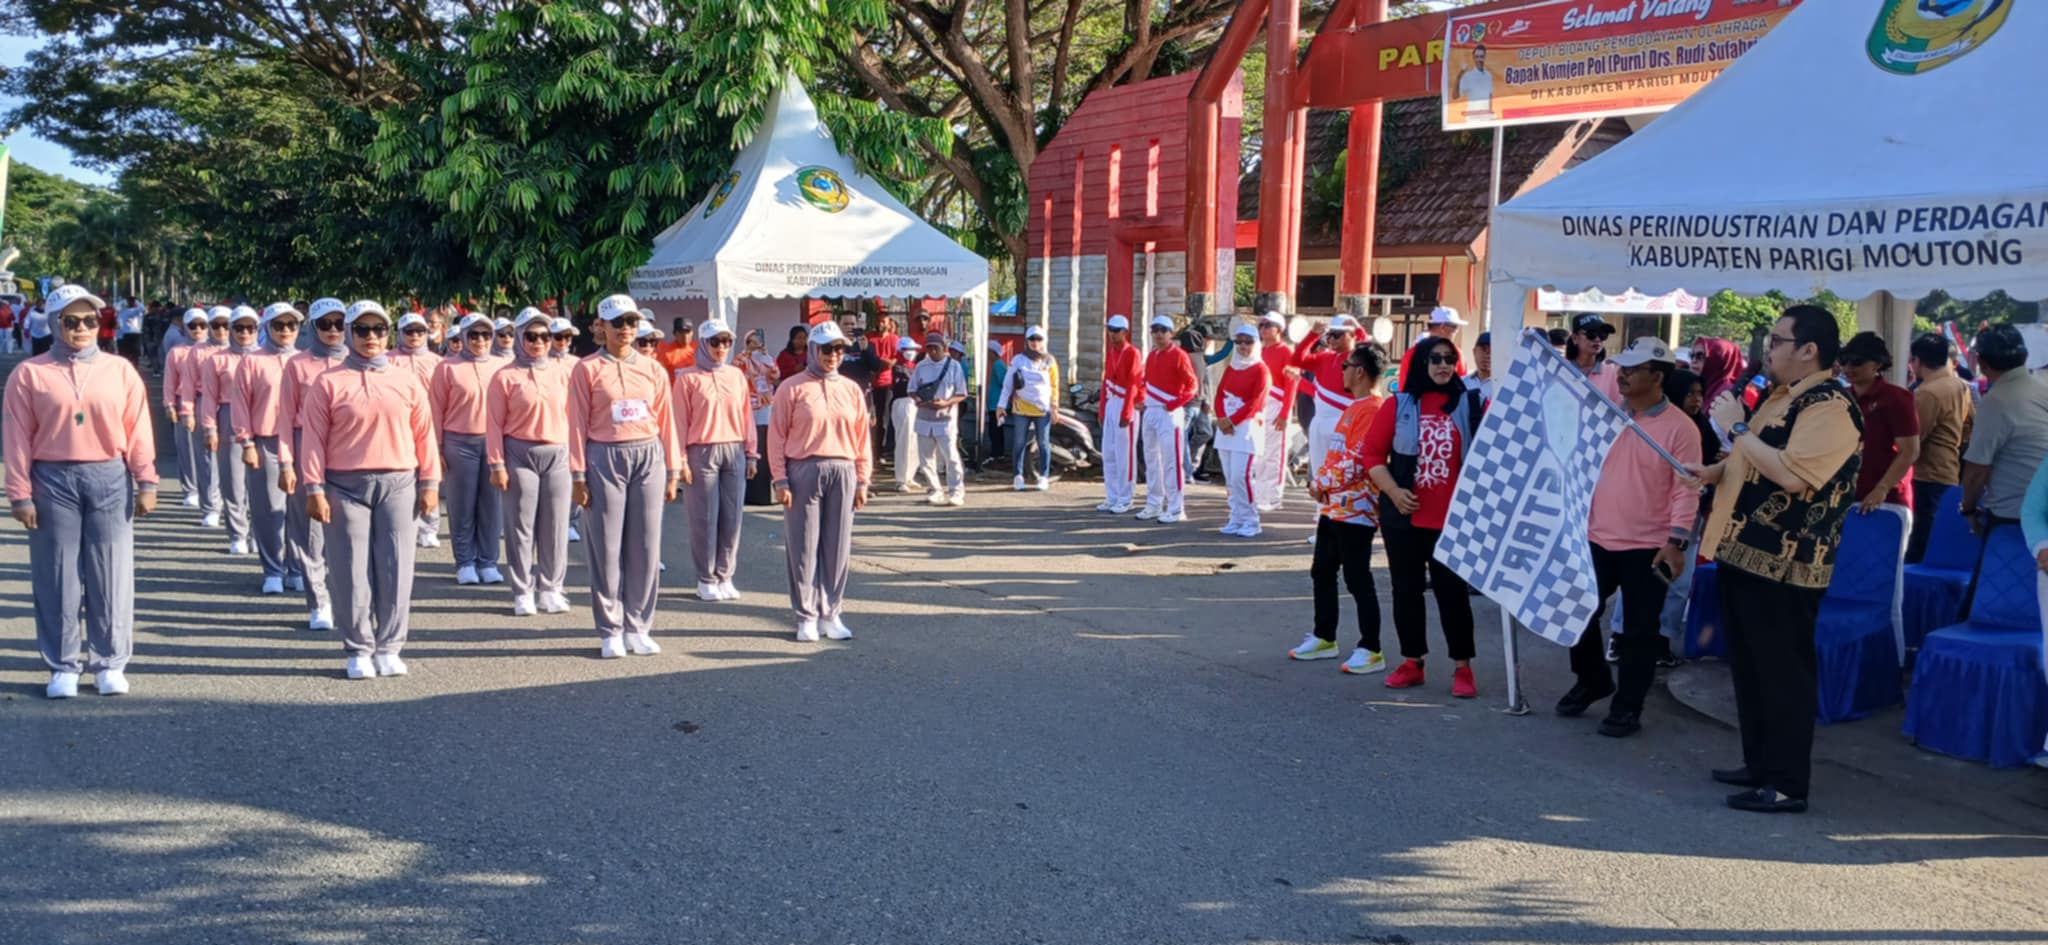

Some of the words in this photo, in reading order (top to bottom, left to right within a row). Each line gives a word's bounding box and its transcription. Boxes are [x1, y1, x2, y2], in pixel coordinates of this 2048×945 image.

[1562, 1, 1637, 31] Selamat
[1519, 46, 1556, 60] DEPUTI
[1559, 39, 1600, 56] BIDANG
[1698, 17, 1768, 38] OLAHRAGA
[1505, 65, 1540, 84] Bapak
[1541, 60, 1585, 80] Komjen
[1587, 56, 1605, 75] Pol
[1608, 51, 1646, 73] (Purn)
[1649, 50, 1673, 68] Drs.
[1676, 43, 1705, 66] Rudi
[1546, 81, 1623, 98] KABUPATEN
[1627, 74, 1674, 90] PARIGI
[1679, 68, 1724, 84] MOUT
[1562, 215, 1623, 237] DINAS
[1629, 214, 1818, 239] PERINDUSTRIAN
[1827, 209, 1886, 237] DAN
[755, 262, 784, 273] DINAS
[786, 263, 859, 275] PERINDUSTRIAN
[860, 265, 880, 275] DAN
[882, 265, 948, 276] PERDAGANGAN
[1630, 245, 1762, 270] KABUPATEN
[1770, 247, 1852, 272] PARIGI
[1863, 238, 2023, 268] MOUTONG
[786, 275, 841, 287] KABUPATEN
[873, 277, 920, 288] MOUTONG
[620, 407, 640, 418] 001
